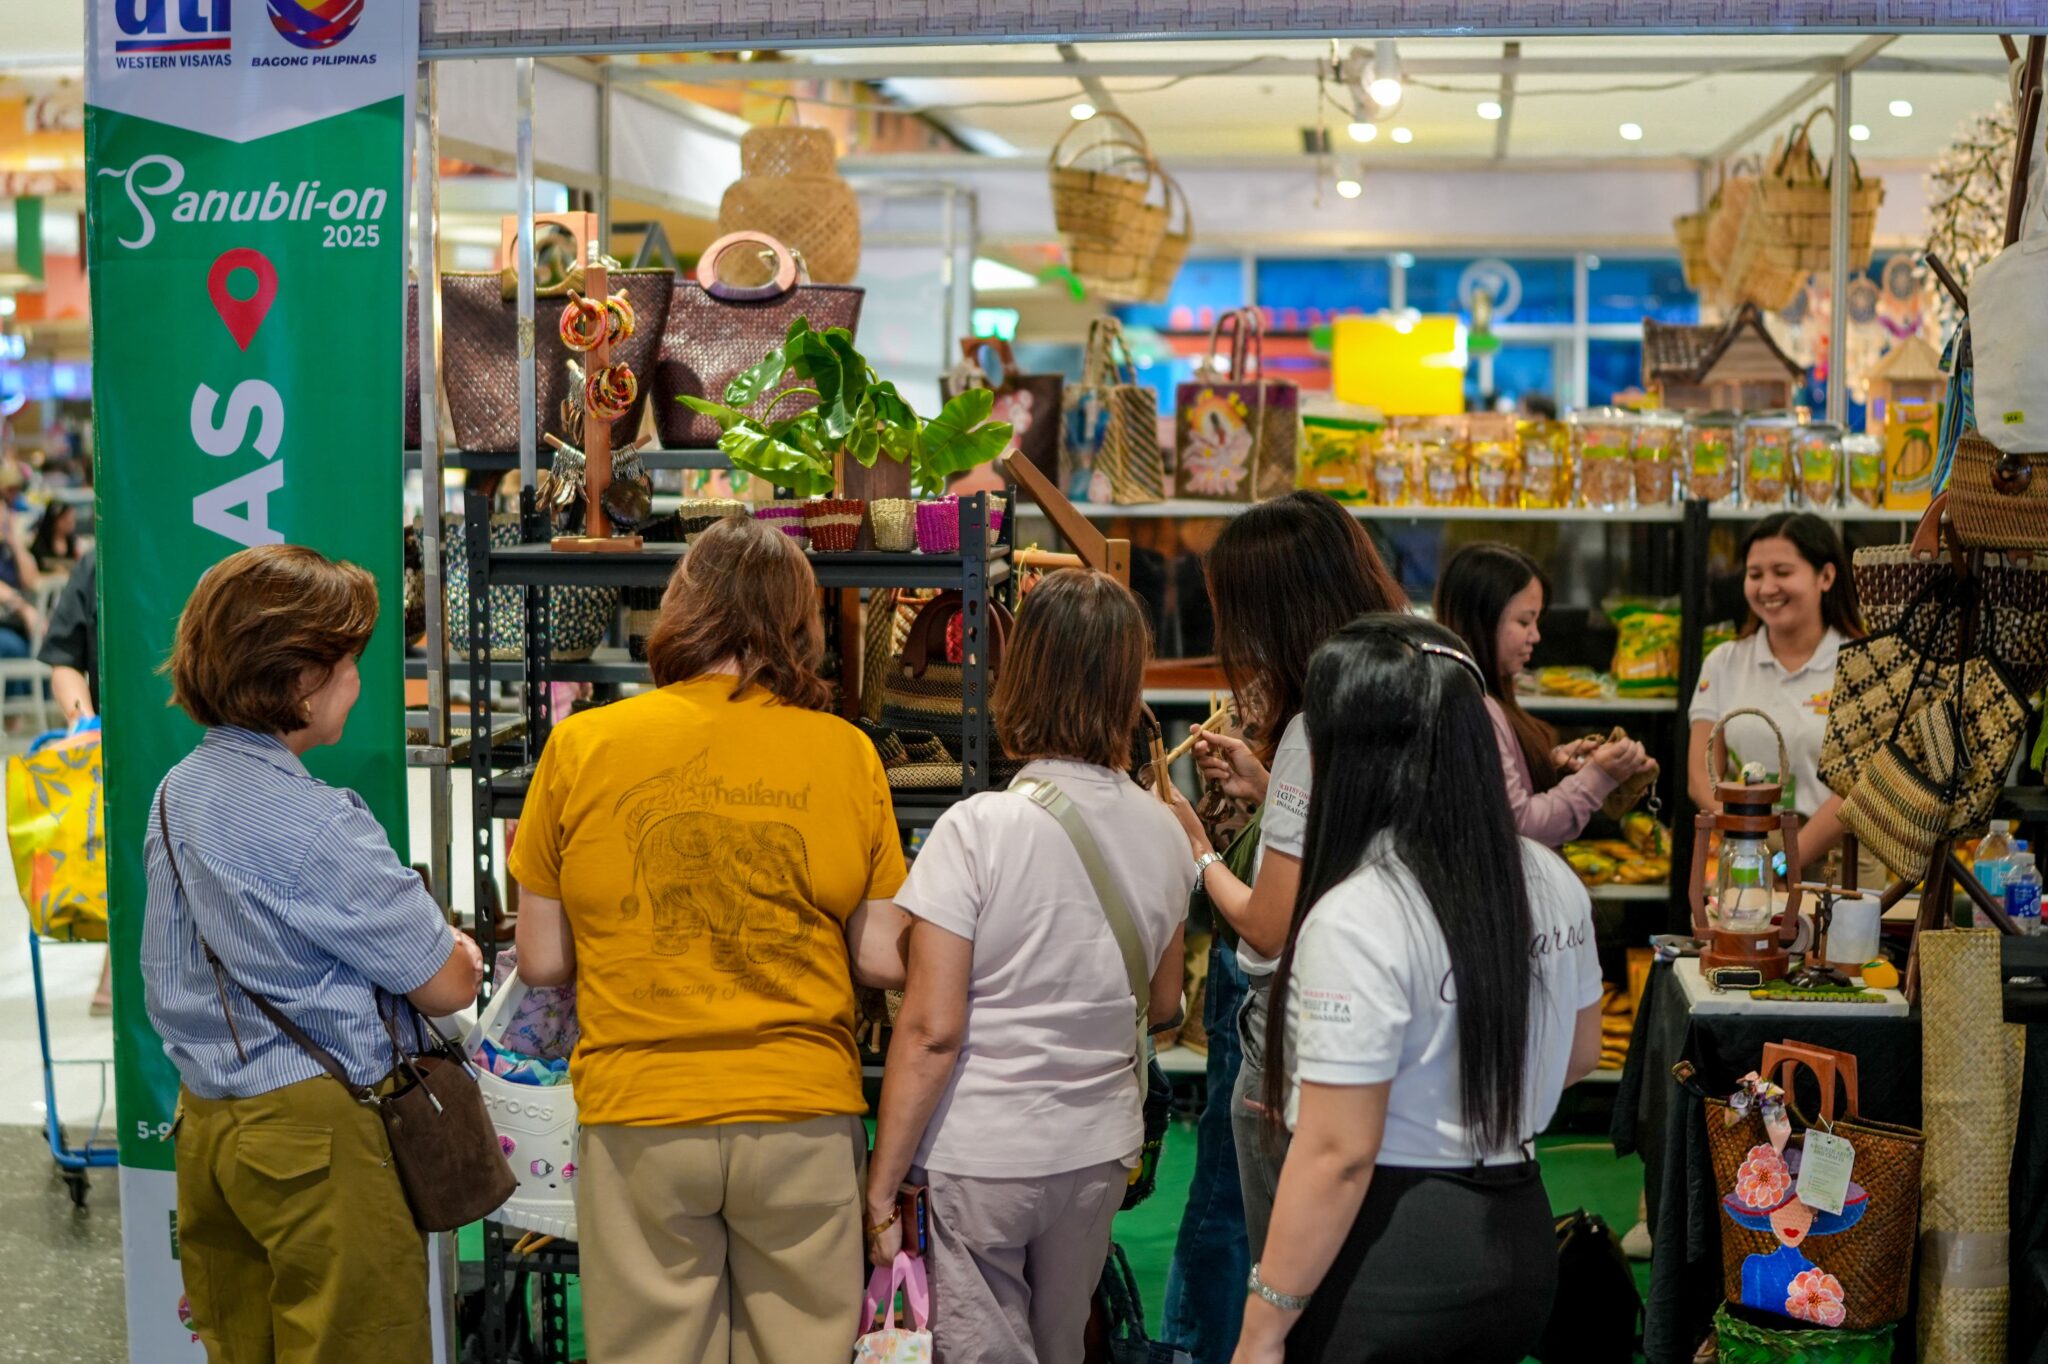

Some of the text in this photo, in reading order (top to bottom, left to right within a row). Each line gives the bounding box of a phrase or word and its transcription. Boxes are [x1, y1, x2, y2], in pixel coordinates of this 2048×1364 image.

[116, 54, 232, 69] WESTERN VISAYAS
[251, 54, 377, 67] BAGONG PILIPINAS
[97, 154, 387, 249] Panubli-on
[322, 225, 380, 247] 2025
[190, 379, 285, 548] AS
